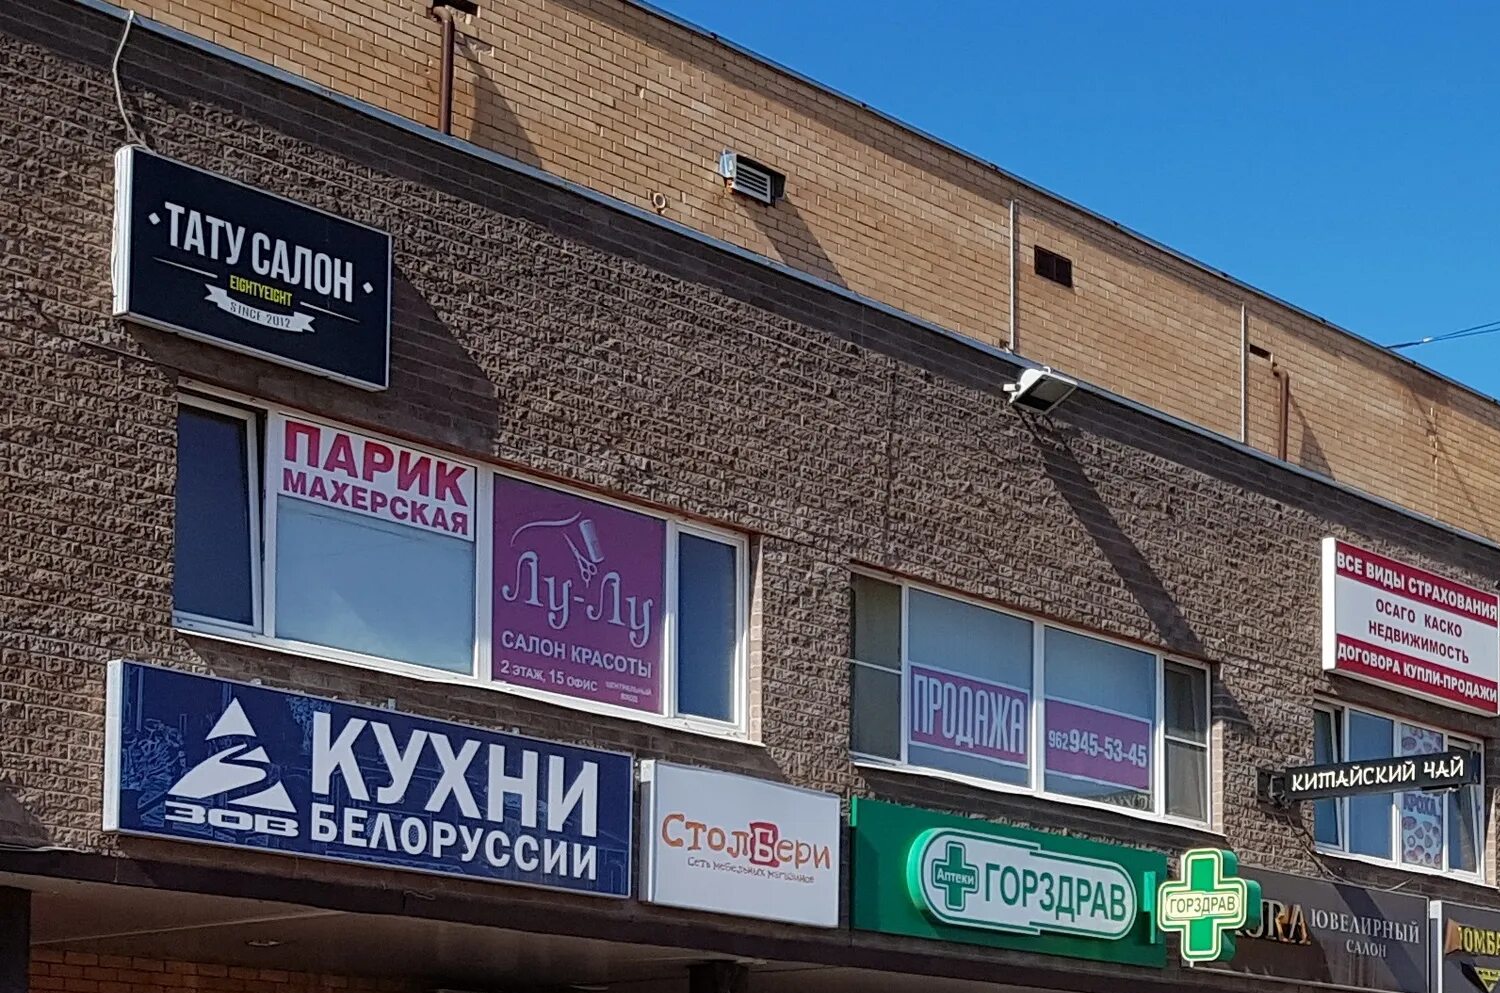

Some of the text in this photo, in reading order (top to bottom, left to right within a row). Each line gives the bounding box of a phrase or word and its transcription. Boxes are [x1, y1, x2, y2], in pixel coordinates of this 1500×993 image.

[165, 201, 352, 302] ТАТУ САЛОН
[229, 274, 293, 307] EIGHTYEIGHT
[230, 302, 262, 321] SINCE
[284, 420, 468, 507] ПАРИК
[282, 469, 468, 536] МАХЕРСКАЯ
[502, 550, 653, 648] Лу-Лу
[1336, 553, 1498, 621] ВСЕ ВИДЫ СТРАХОВАНИЯ
[1375, 598, 1463, 638] ОСАГО КАСКО
[502, 631, 651, 678] САЛОН КРАСОТЫ
[1368, 620, 1469, 664] НЕДВИЖИМОСТЬ
[500, 660, 598, 692] 2 ЭТАЖ, 15 ОФИС
[1337, 642, 1498, 702] ДОГОВОРА КУПЛИ-ПРОДАЖИ
[913, 673, 1025, 755] ПРОДАЖА
[1048, 729, 1147, 768] 962 945-53-45
[311, 711, 599, 838] КУХНИ
[1291, 755, 1465, 792] КИТАЙСКИЙ ЧАЙ
[165, 800, 299, 837] ЗОВ
[310, 803, 598, 881] БЕЛОРУССИИ
[937, 867, 975, 886] Аптеки
[984, 862, 1127, 923] ГОРЗДРАВ
[1169, 894, 1236, 915] ГОРЗДРАВ
[1311, 908, 1420, 944] ЮВЕЛИРНЫЙ
[1346, 939, 1387, 958] САЛОН
